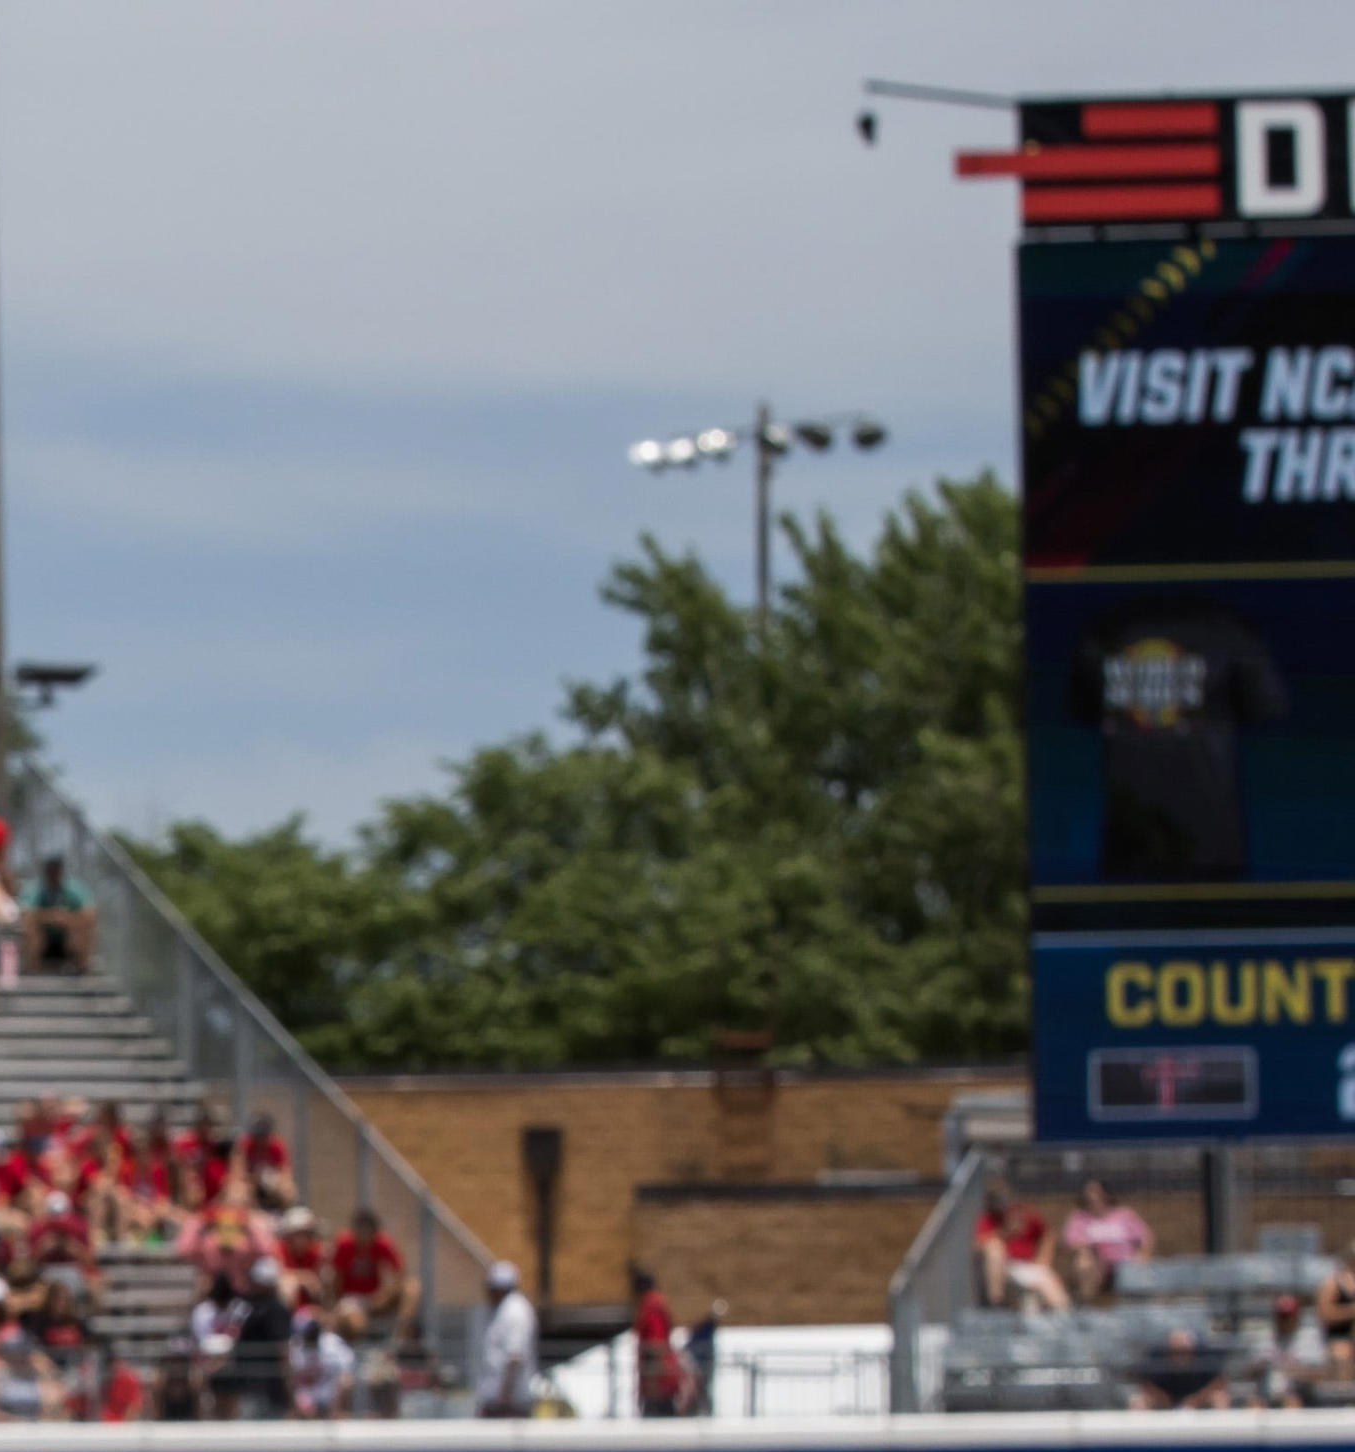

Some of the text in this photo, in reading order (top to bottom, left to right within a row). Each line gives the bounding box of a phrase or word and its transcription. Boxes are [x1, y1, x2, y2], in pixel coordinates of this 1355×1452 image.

[1236, 100, 1355, 218] D
[1078, 346, 1355, 425] VISIT NC
[1105, 959, 1355, 1027] COUNT
